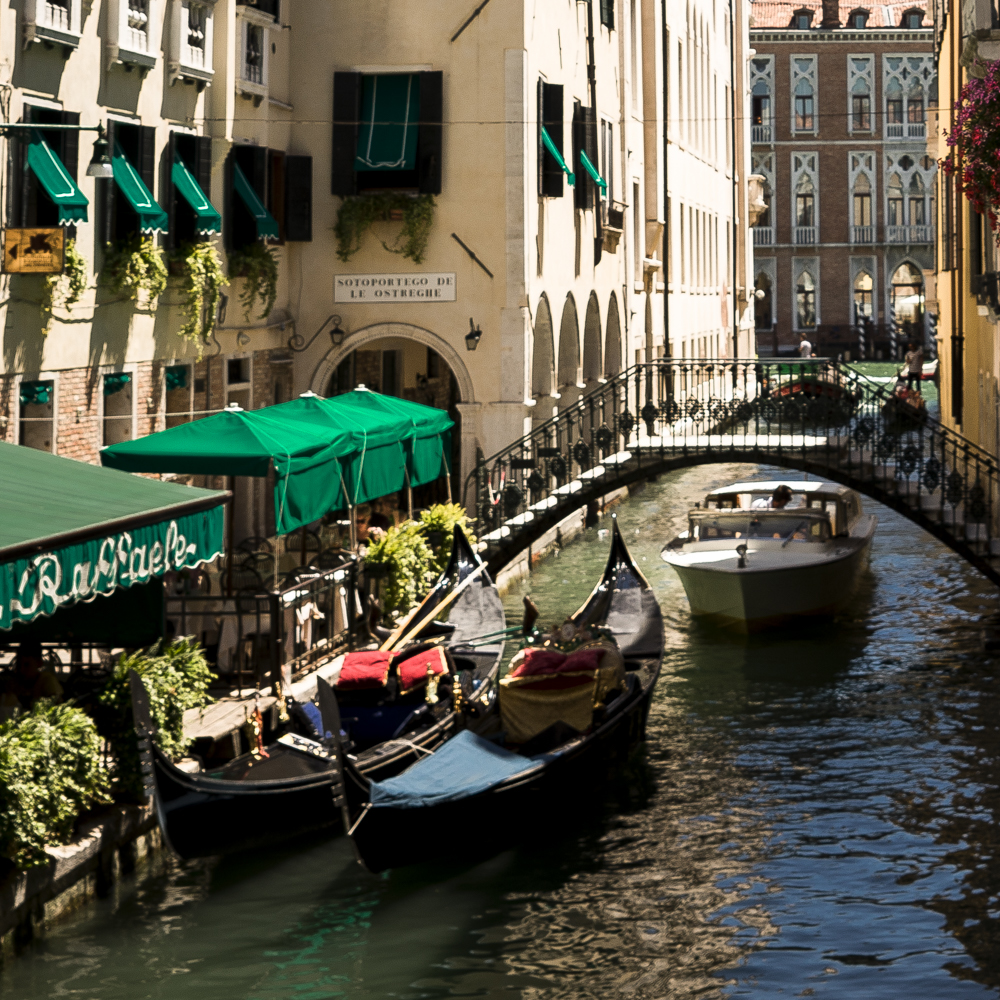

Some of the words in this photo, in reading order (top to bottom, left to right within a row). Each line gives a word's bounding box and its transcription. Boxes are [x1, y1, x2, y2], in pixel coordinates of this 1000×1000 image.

[337, 278, 429, 287] SOTOPORTEGO
[437, 277, 453, 286] DE
[350, 290, 366, 298] LE
[374, 289, 442, 297] OSTREGHE
